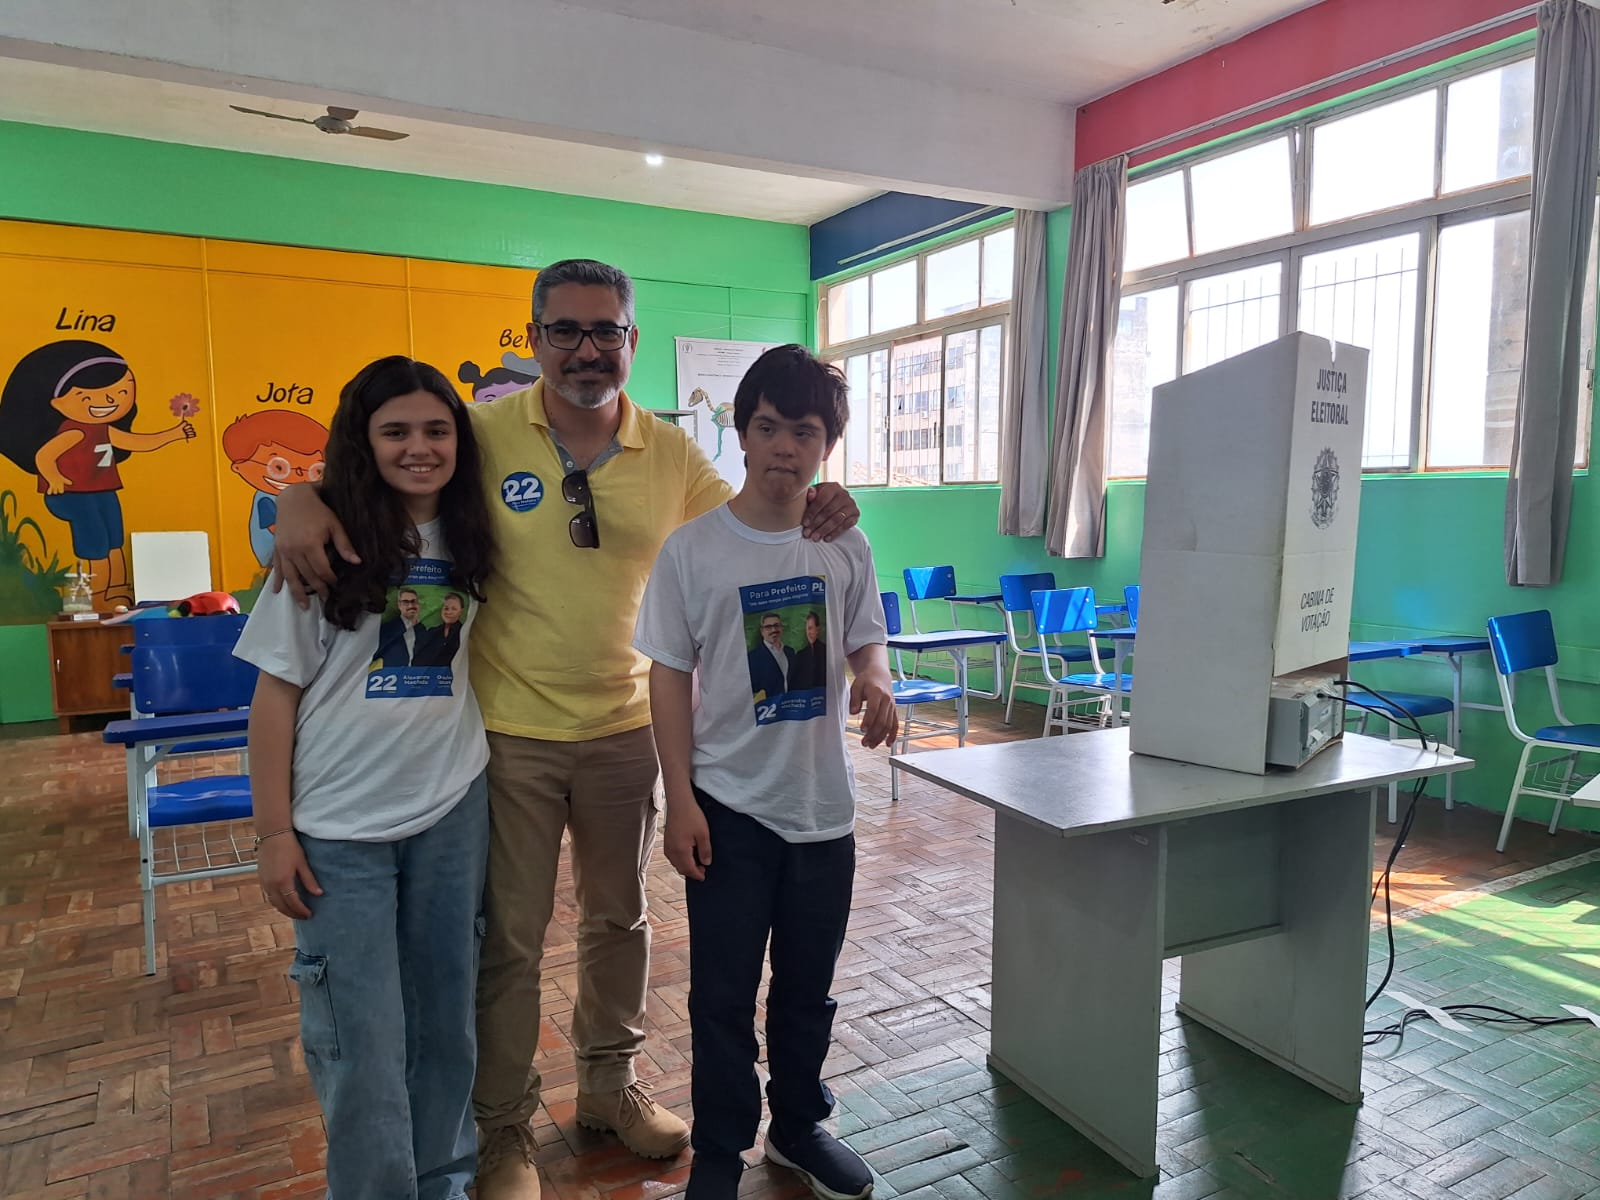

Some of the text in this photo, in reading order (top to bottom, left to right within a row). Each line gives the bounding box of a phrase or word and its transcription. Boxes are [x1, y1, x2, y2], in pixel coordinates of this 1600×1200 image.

[55, 306, 116, 333] Lina
[256, 381, 314, 405] Jota
[1316, 368, 1348, 399] JUSTIÇA
[1310, 400, 1349, 425] ELEITORAL
[94, 443, 114, 467] 7
[503, 477, 541, 503] 22
[749, 591, 770, 600] Para
[771, 583, 807, 596] Prefeito
[811, 582, 825, 592] PL
[1300, 586, 1336, 610] CABINA DE
[1301, 607, 1331, 633] VOTAÇÃO
[367, 674, 398, 692] 22
[756, 703, 777, 721] 22
